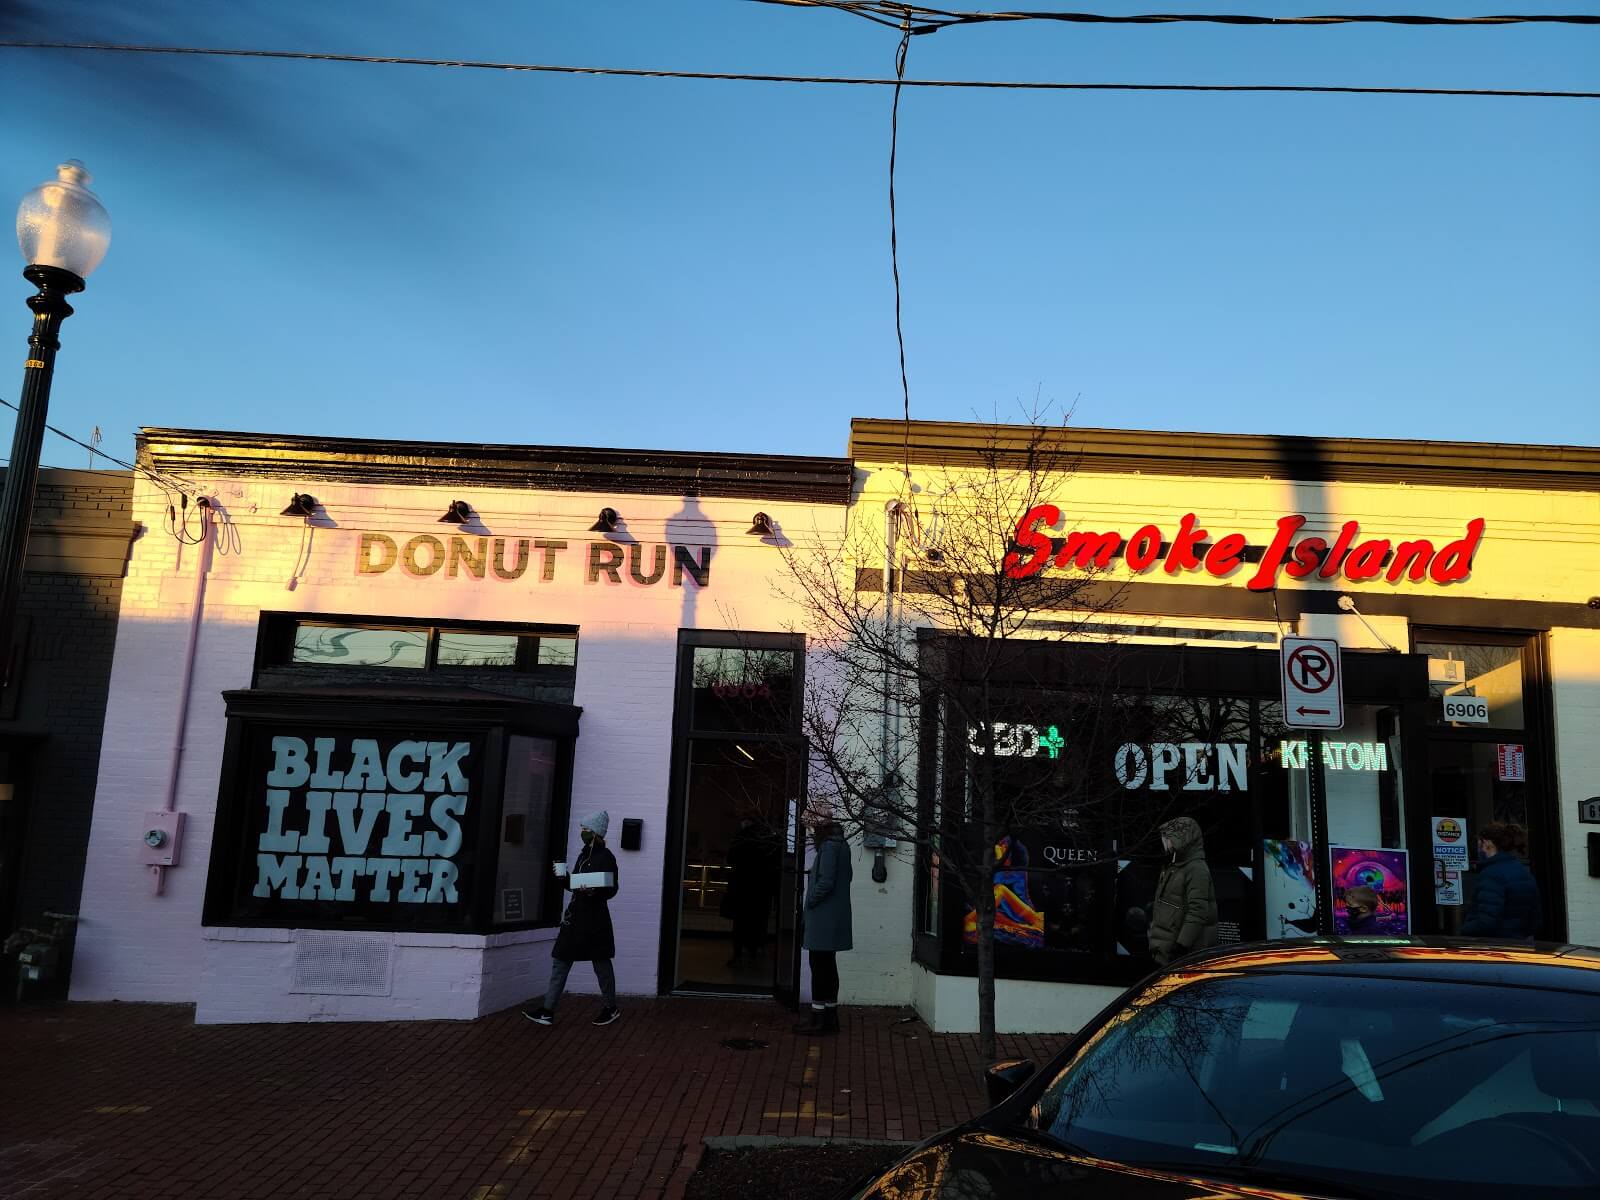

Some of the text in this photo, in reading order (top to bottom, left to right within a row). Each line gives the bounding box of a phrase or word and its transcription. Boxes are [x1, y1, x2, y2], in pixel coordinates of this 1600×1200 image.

[357, 533, 712, 588] DONUT RUN
[1004, 504, 1485, 591] Smoke Island
[1445, 703, 1486, 718] 6906
[267, 736, 471, 793] BLACK
[1114, 742, 1248, 791] OPEN
[258, 789, 468, 858] LIVES
[252, 853, 459, 904] MATTER
[1043, 846, 1098, 865] QUEEN
